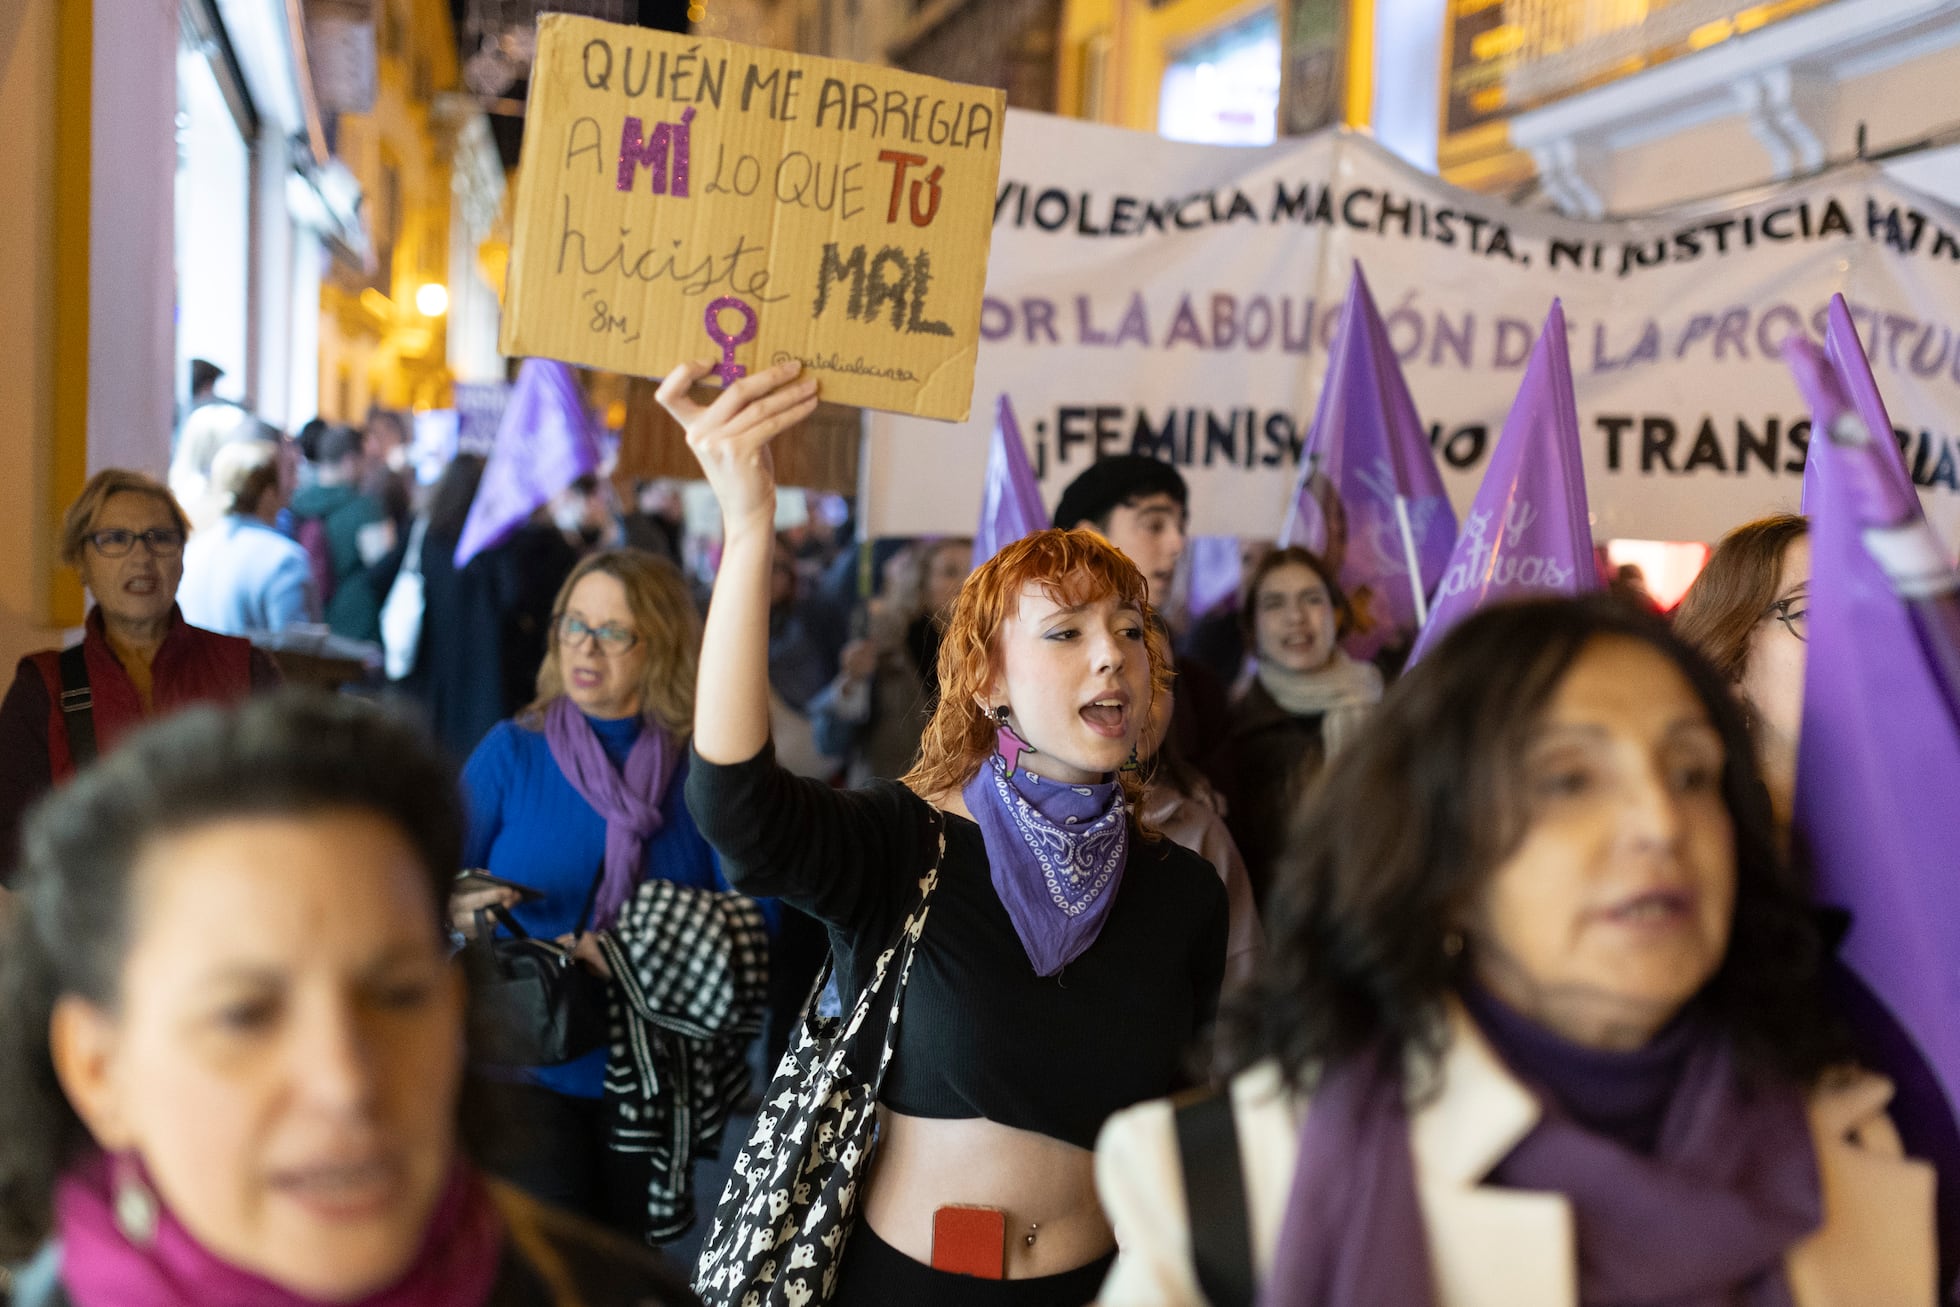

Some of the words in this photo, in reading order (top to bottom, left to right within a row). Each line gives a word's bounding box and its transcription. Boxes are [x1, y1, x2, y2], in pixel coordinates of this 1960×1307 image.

[582, 39, 727, 108] QUIÉN
[741, 64, 803, 121] ME
[816, 78, 993, 150] ARREGLA
[566, 117, 603, 174] A
[616, 106, 696, 198] MÍ
[705, 144, 761, 196] LO
[774, 152, 865, 220] QUE
[878, 150, 945, 228] TÚ
[557, 194, 789, 302] hiciste
[811, 242, 954, 337] MAL
[1270, 180, 1531, 269] MACHISTA,
[1549, 238, 1600, 273] NI
[1617, 196, 1854, 279] JUSTICIA
[1075, 292, 1151, 348] LA
[1591, 318, 1661, 373] LA
